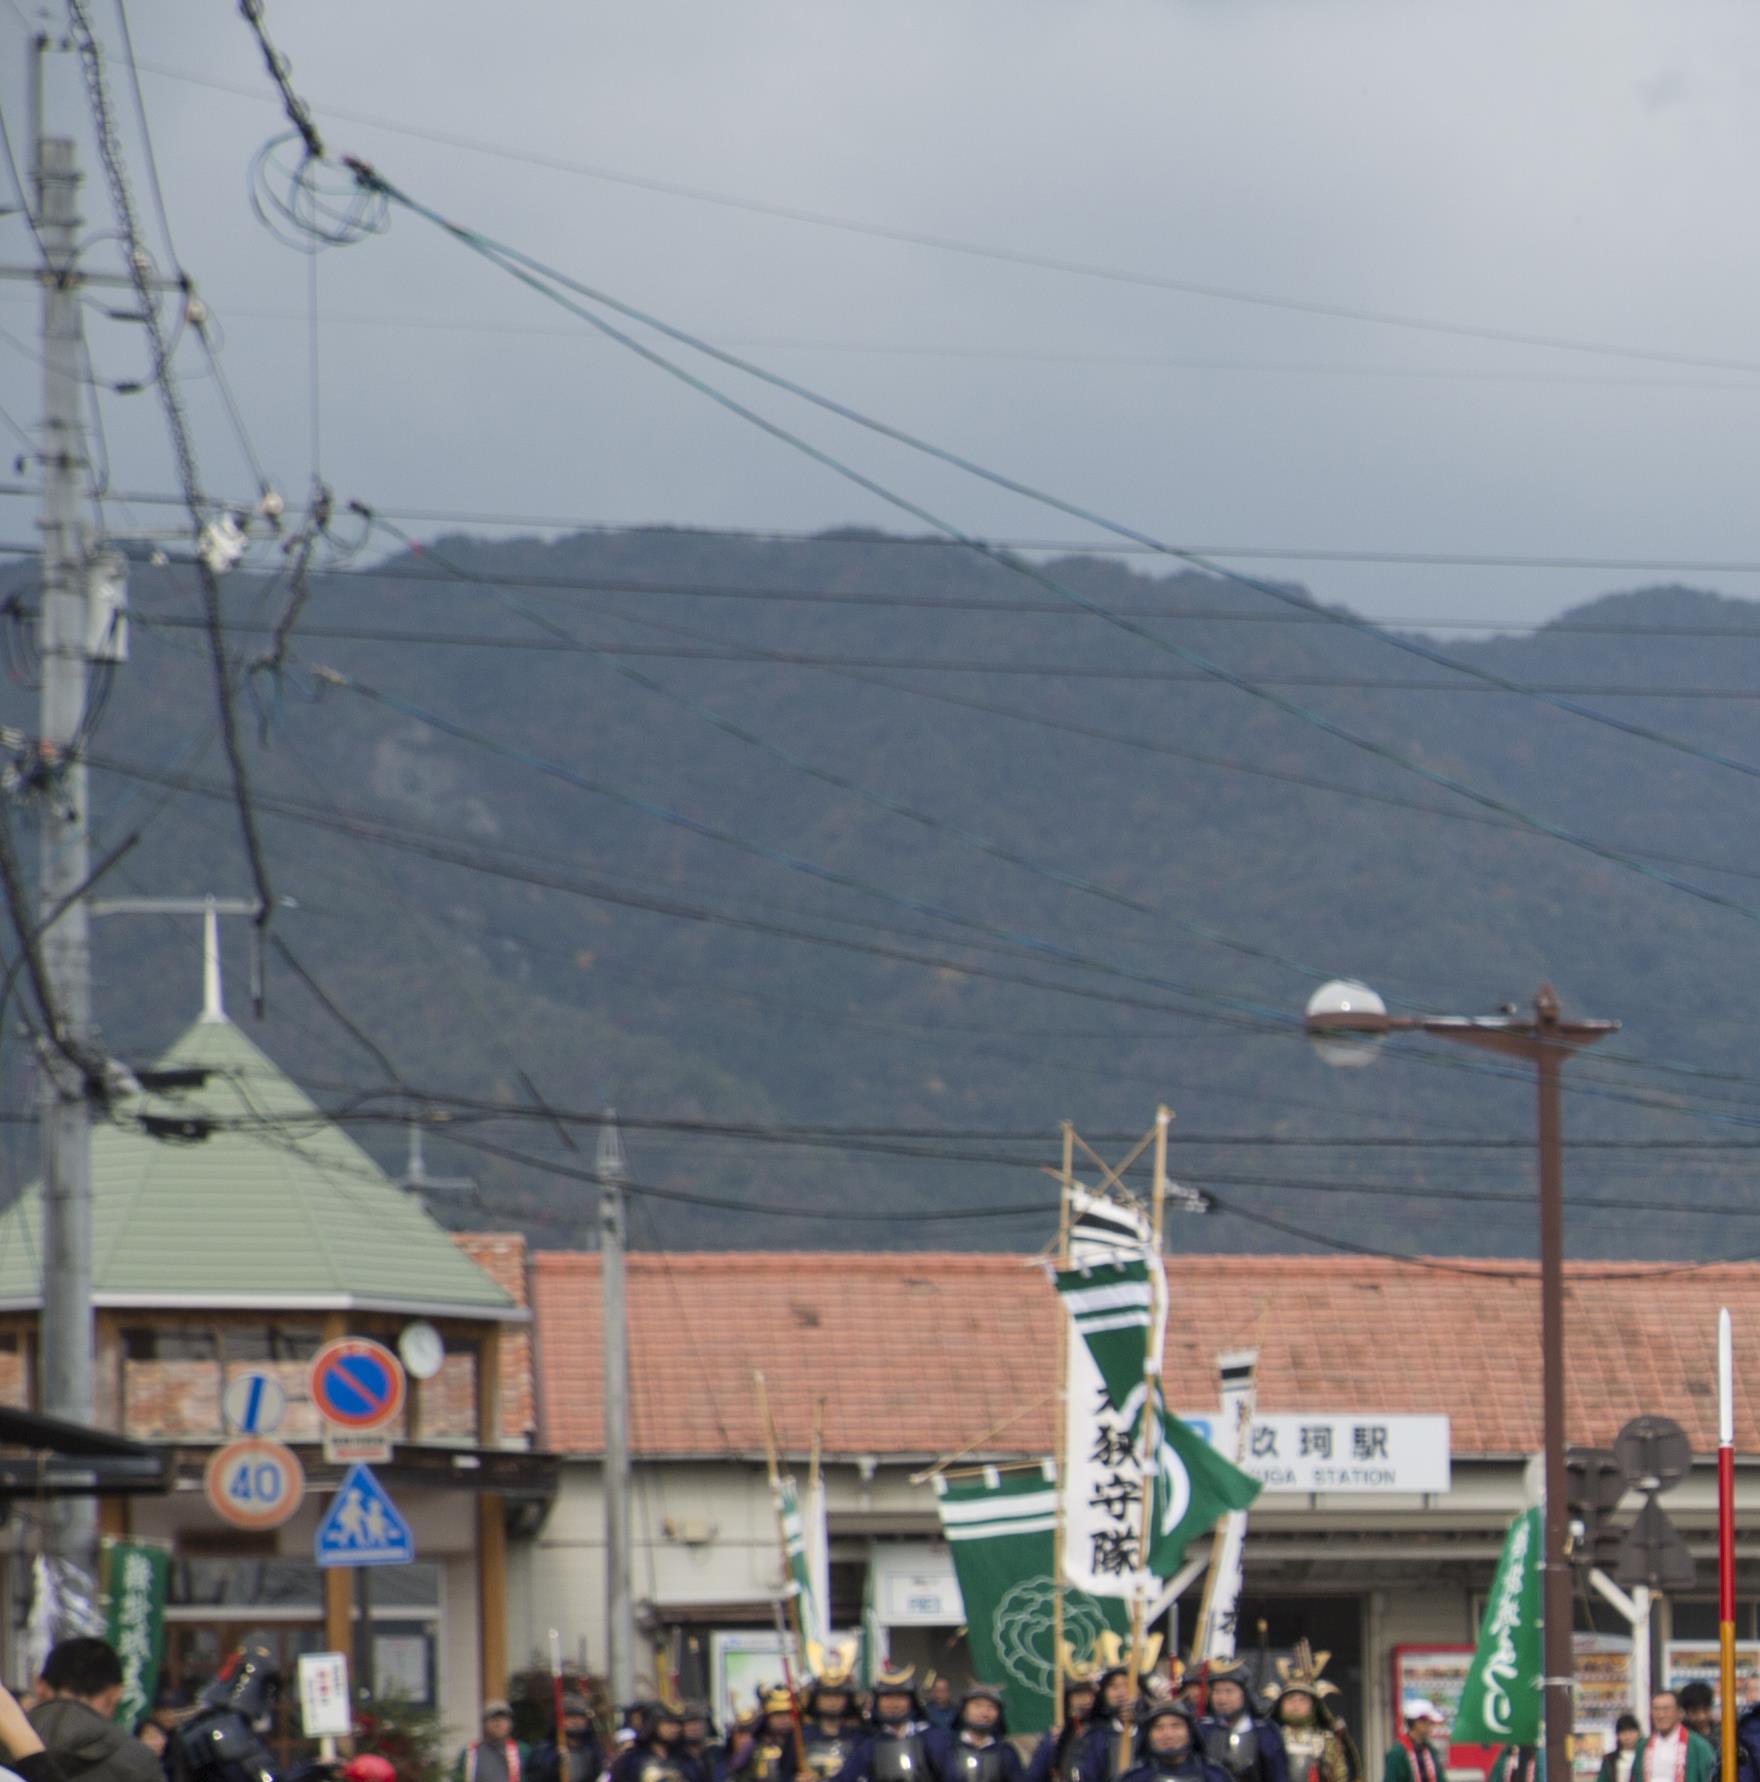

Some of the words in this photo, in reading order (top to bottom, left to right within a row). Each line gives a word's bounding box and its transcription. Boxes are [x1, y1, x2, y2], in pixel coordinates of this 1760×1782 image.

[230, 1463, 281, 1502] 40
[1089, 1388, 1142, 1575] 狭守隊
[1314, 1469, 1396, 1485] STATION
